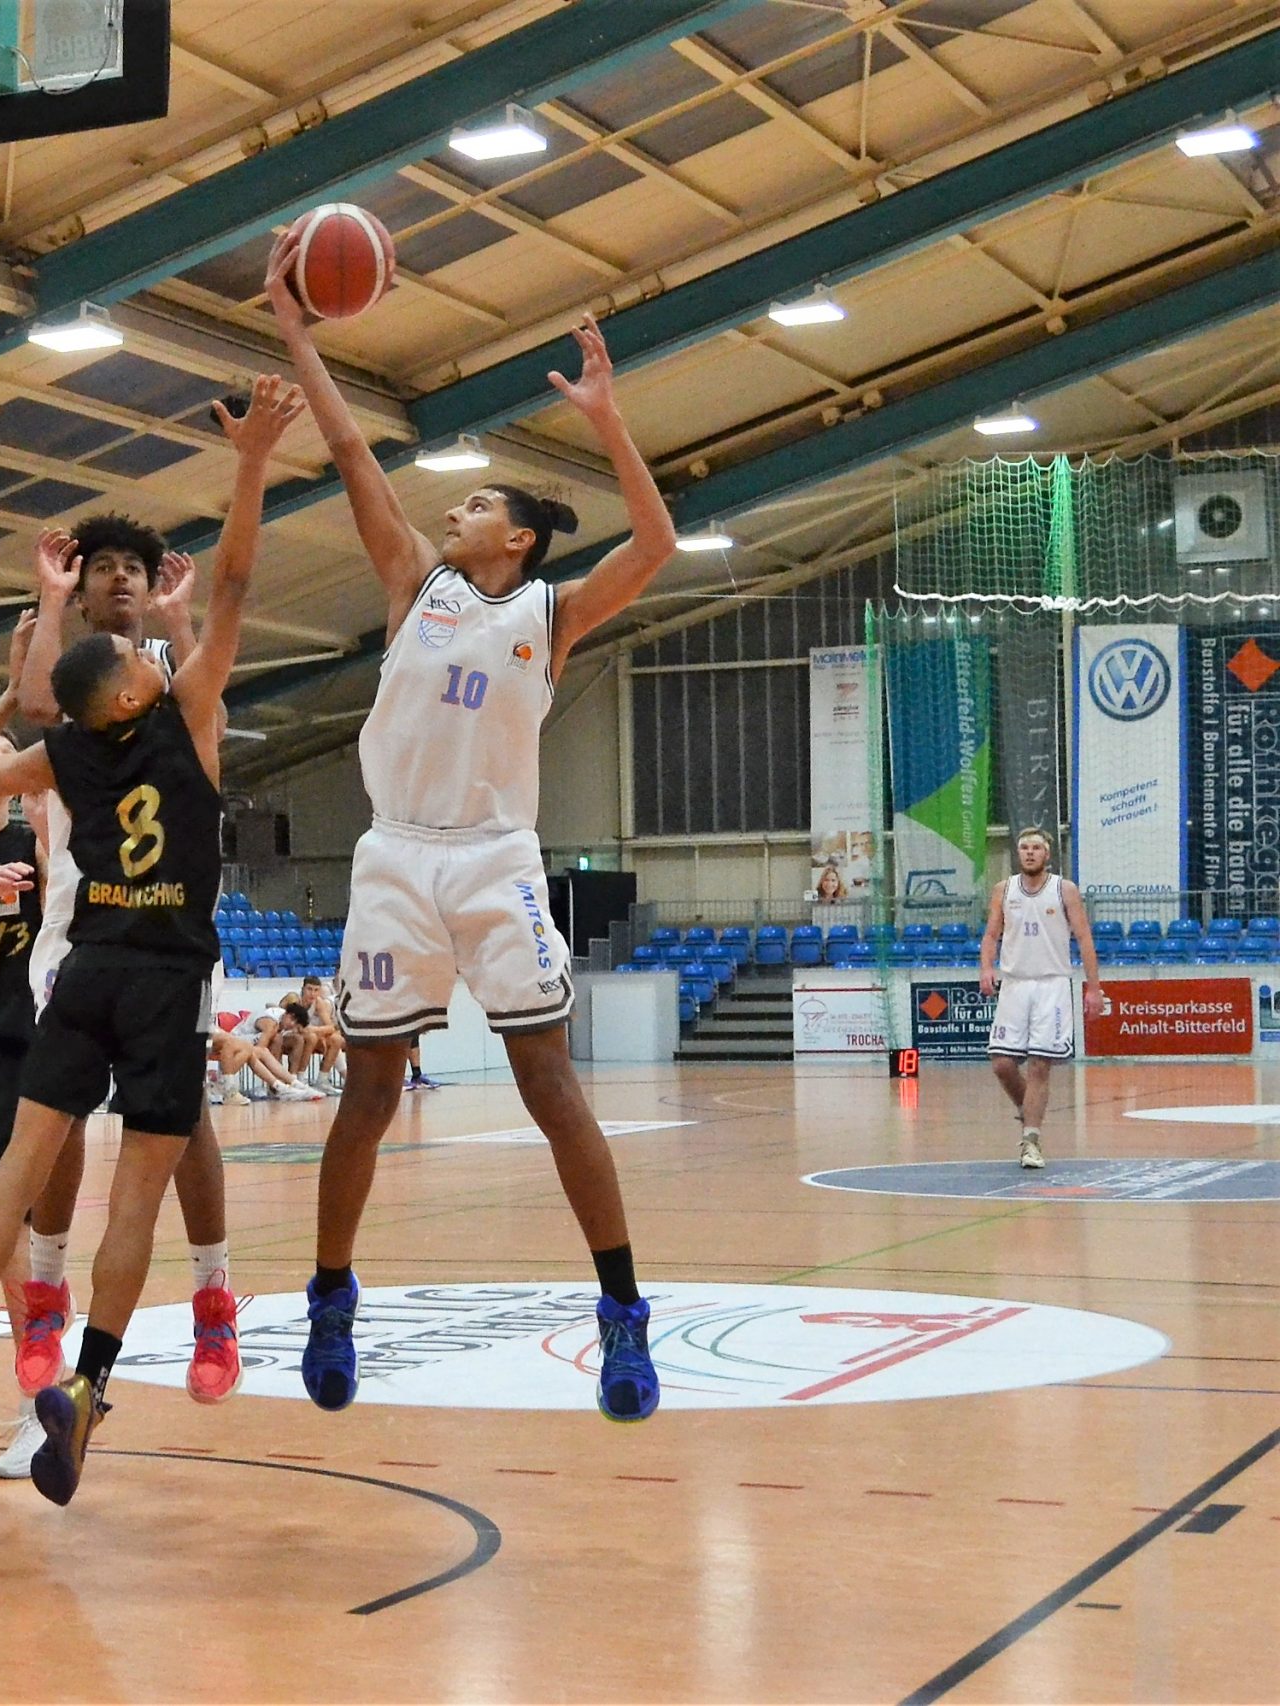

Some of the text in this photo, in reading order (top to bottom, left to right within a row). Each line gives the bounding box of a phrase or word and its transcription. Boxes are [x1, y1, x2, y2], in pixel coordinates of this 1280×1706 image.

[441, 664, 489, 710] 10
[1201, 638, 1220, 714] Baustoffe
[1100, 778, 1158, 803] Kompetenz
[1203, 732, 1220, 838] Bauelemente
[1111, 794, 1147, 812] schafft
[1228, 704, 1253, 910] für alle die bauen
[116, 784, 165, 878] 8
[358, 951, 394, 991] 10
[954, 1006, 996, 1020] für all
[1120, 1001, 1233, 1017] Kreissparkasse
[1120, 1019, 1246, 1035] Anhalt-Bitterfeld
[898, 1049, 917, 1074] 18
